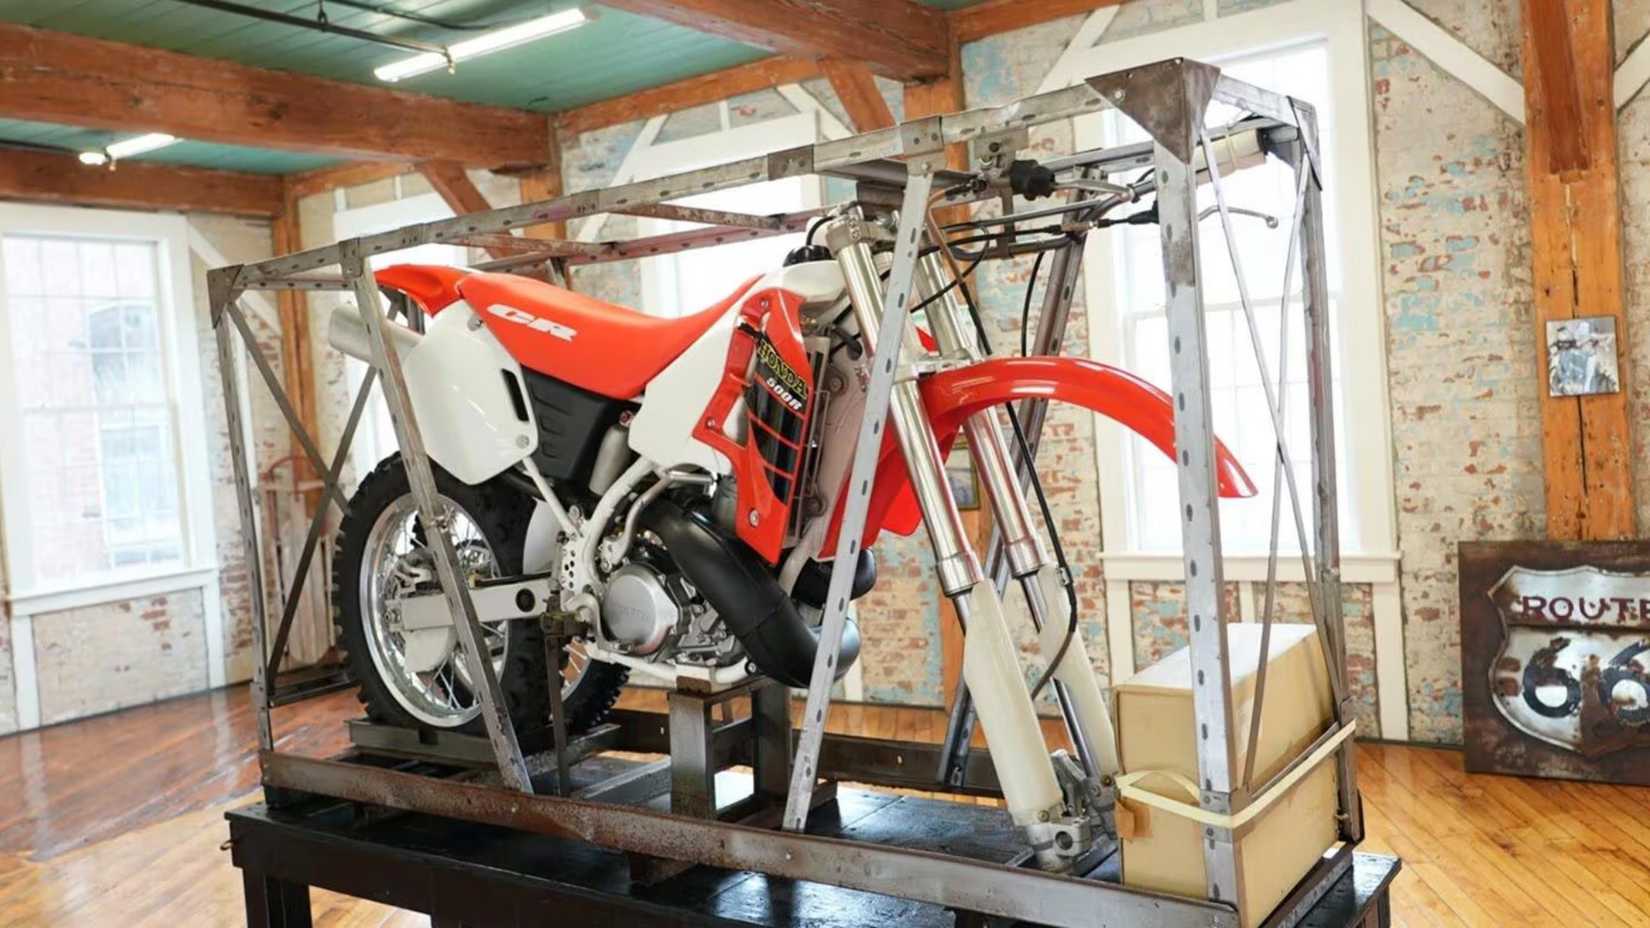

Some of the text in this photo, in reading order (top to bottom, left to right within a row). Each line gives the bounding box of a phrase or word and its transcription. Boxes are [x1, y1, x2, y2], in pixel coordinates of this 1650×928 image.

[487, 304, 577, 341] CR
[757, 338, 808, 400] HONDA
[766, 378, 802, 410] 500R
[1523, 637, 1650, 721] 66
